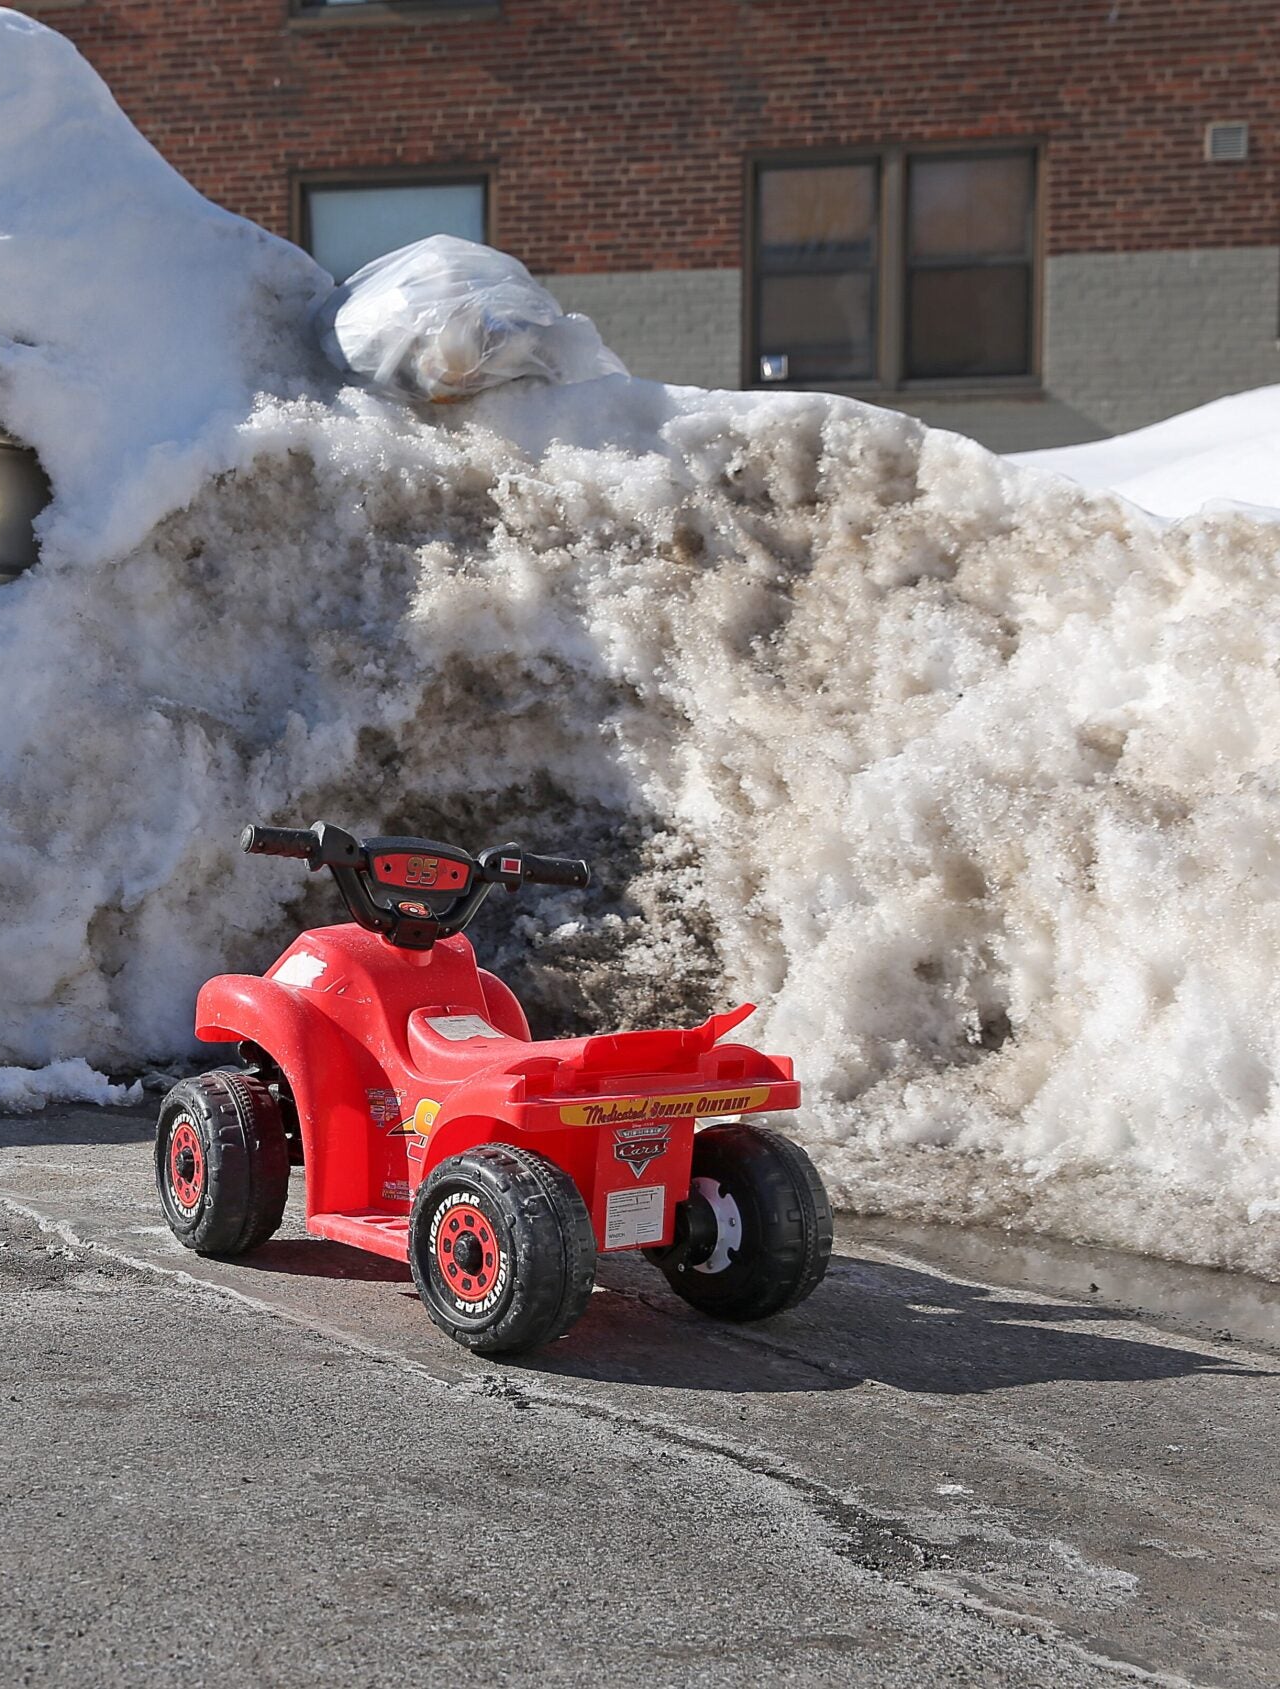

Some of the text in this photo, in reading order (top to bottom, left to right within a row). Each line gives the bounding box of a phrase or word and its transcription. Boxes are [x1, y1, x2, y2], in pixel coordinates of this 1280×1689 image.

[405, 856, 439, 885] 95
[582, 1100, 649, 1125] Medicated
[619, 1144, 661, 1157] Cars
[429, 1192, 481, 1255] LIGHTYEAR
[454, 1250, 508, 1314] LIGHTYEAR
